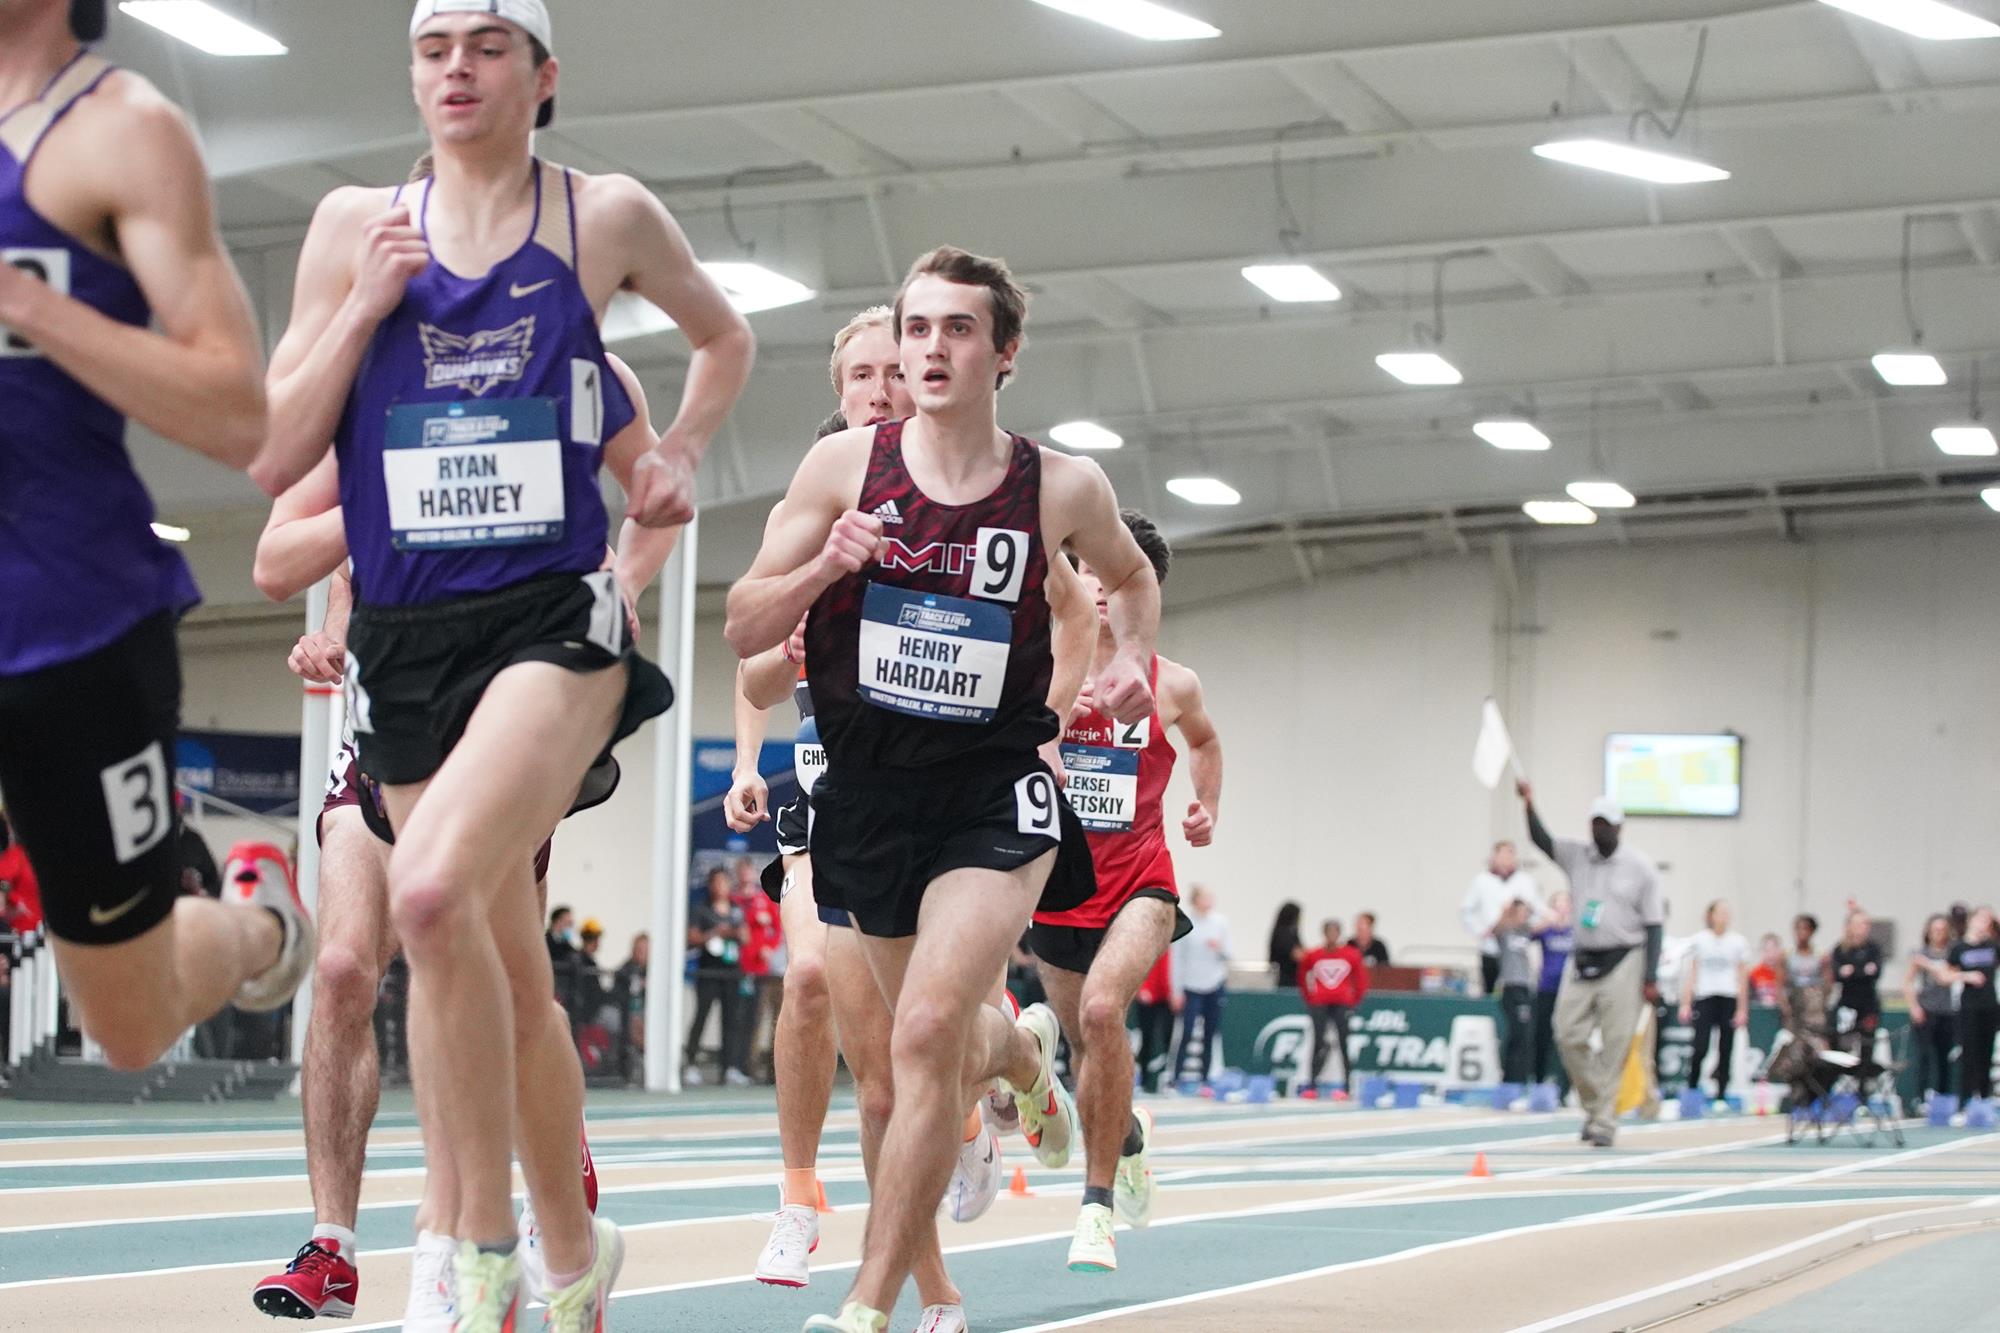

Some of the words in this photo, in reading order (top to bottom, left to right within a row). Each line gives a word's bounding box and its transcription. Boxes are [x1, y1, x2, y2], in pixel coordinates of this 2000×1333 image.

[584, 369, 599, 439] 1
[438, 453, 498, 480] RYAN
[419, 484, 523, 518] HARVEY
[880, 536, 978, 575] MI
[983, 532, 1017, 595] 9
[898, 635, 962, 665] HENRY
[876, 657, 982, 698] HARDART
[123, 762, 159, 847] 3
[1026, 774, 1053, 829] 9
[1459, 1045, 1483, 1082] 6
